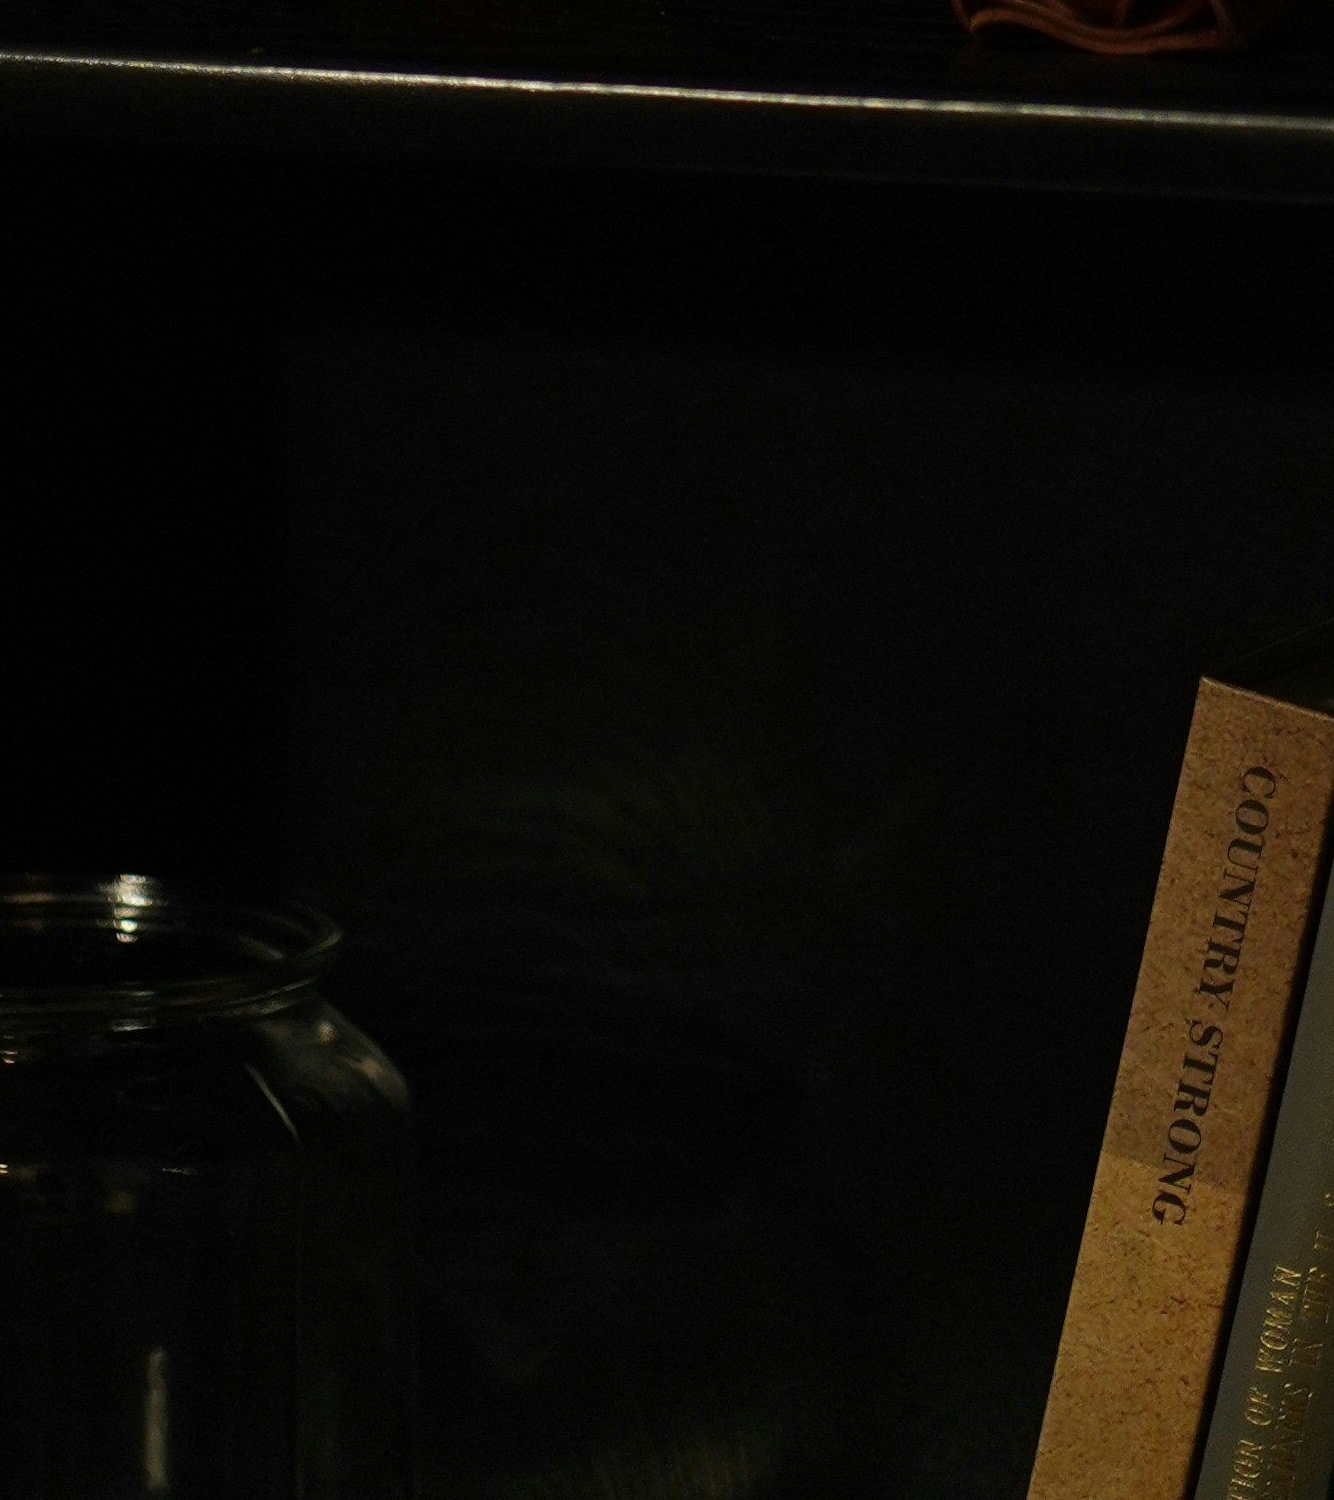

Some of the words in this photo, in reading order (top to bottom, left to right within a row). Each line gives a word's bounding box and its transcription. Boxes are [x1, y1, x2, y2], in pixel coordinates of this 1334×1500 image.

[1197, 765, 1277, 1007] COUNTRY
[1151, 1017, 1226, 1226] STRONG
[1254, 1265, 1303, 1373] WOMAN
